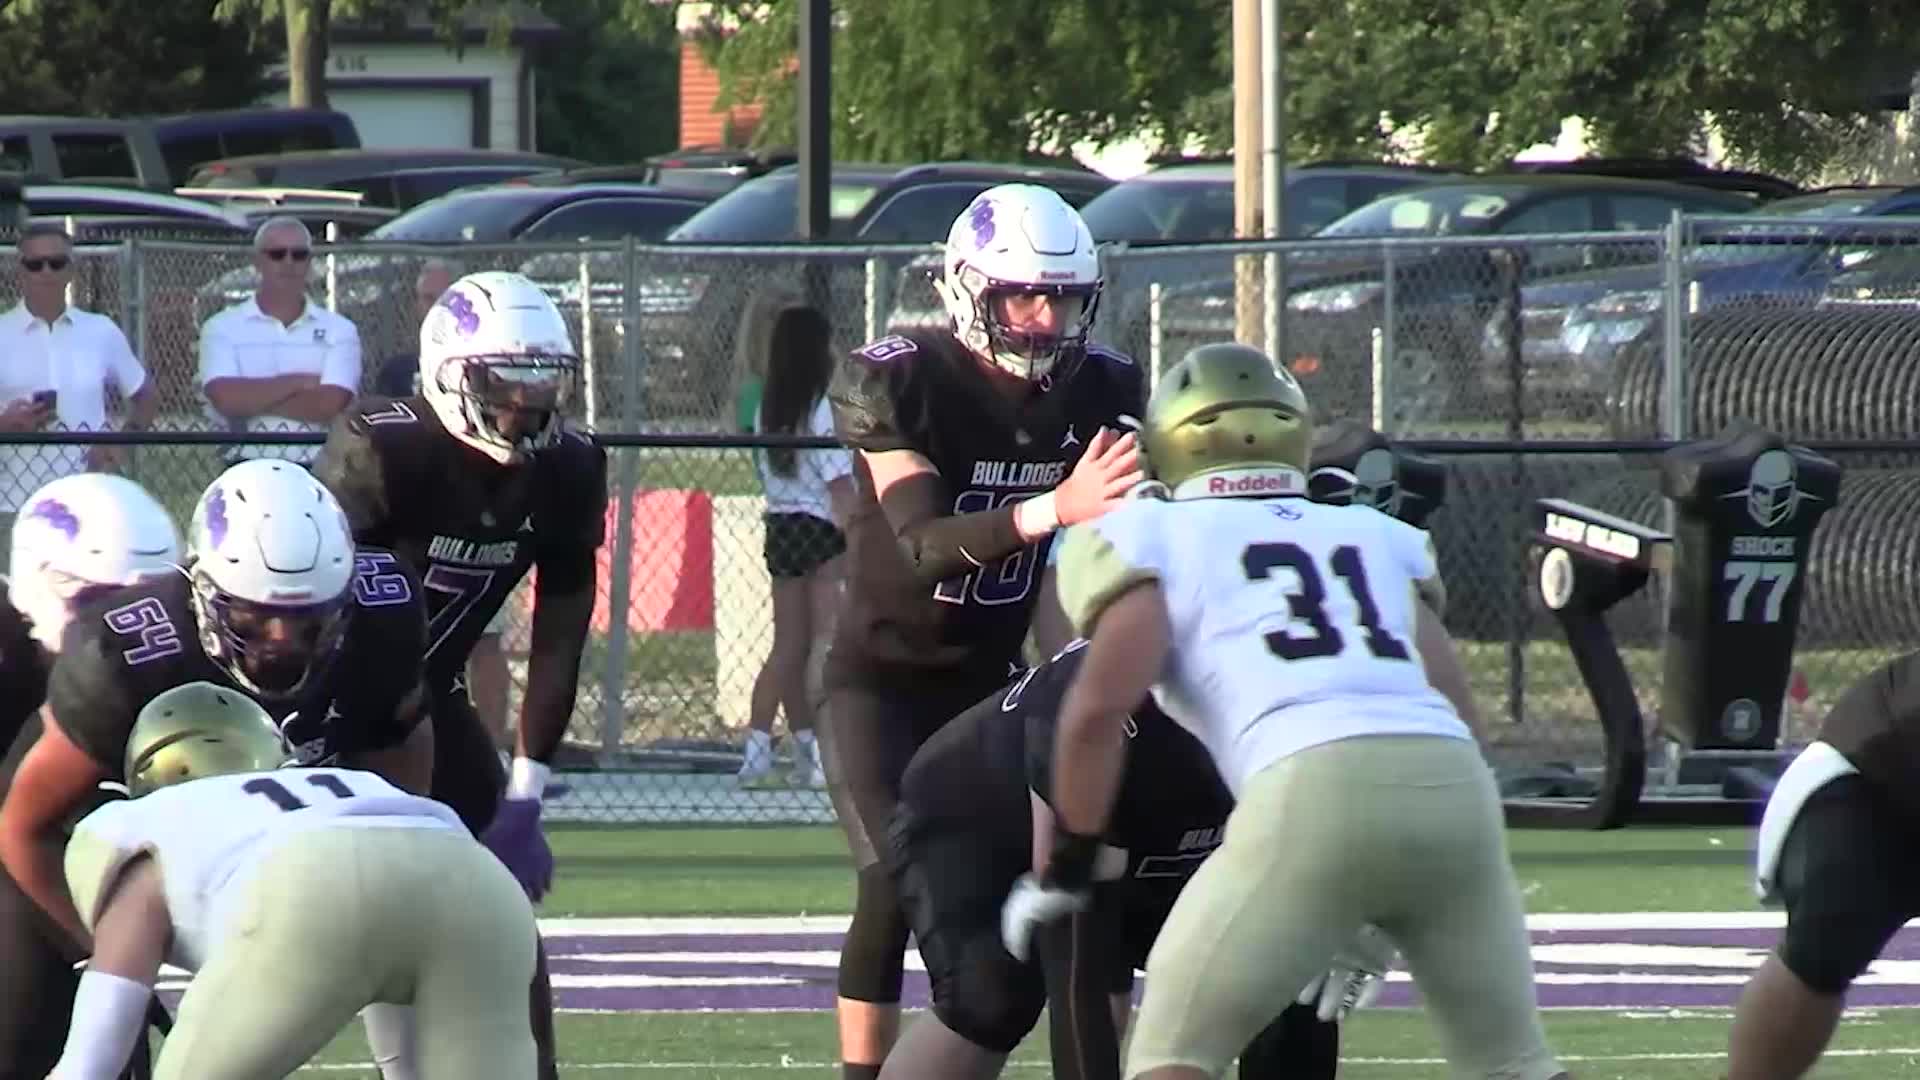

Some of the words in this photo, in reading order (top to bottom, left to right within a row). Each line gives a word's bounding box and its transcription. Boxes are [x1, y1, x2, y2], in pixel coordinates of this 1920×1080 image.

[971, 460, 1066, 487] BULLDOGS
[1208, 473, 1292, 494] Riddell
[1731, 536, 1797, 556] SHOCK
[424, 564, 496, 661] 7
[1242, 542, 1412, 661] 31
[1723, 561, 1798, 622] 77
[104, 597, 182, 665] 64
[241, 774, 357, 813] 11
